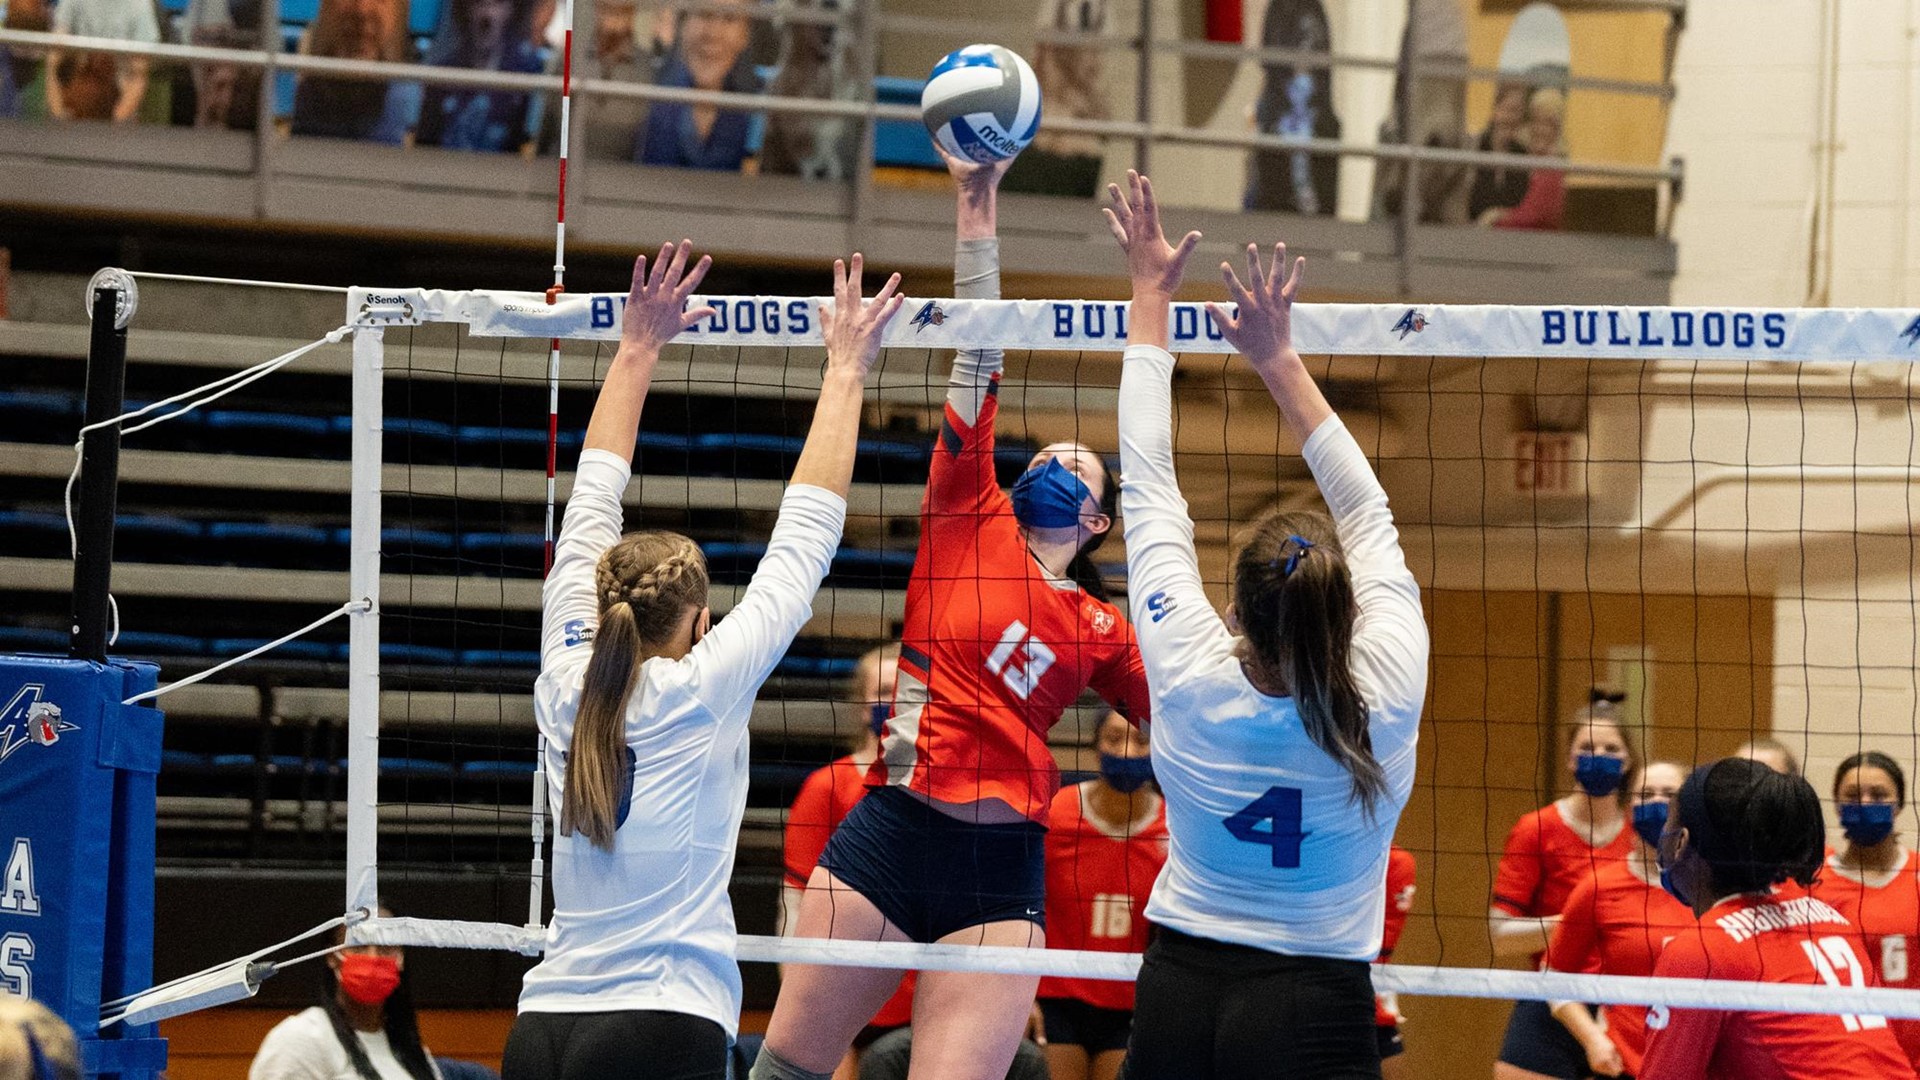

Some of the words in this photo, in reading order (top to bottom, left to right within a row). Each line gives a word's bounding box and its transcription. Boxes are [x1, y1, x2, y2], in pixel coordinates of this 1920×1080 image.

[374, 294, 407, 305] Senoh
[591, 296, 809, 335] BDOGS
[1541, 310, 1786, 348] BULLDOGS
[984, 619, 1057, 701] 13
[1223, 786, 1313, 869] 4
